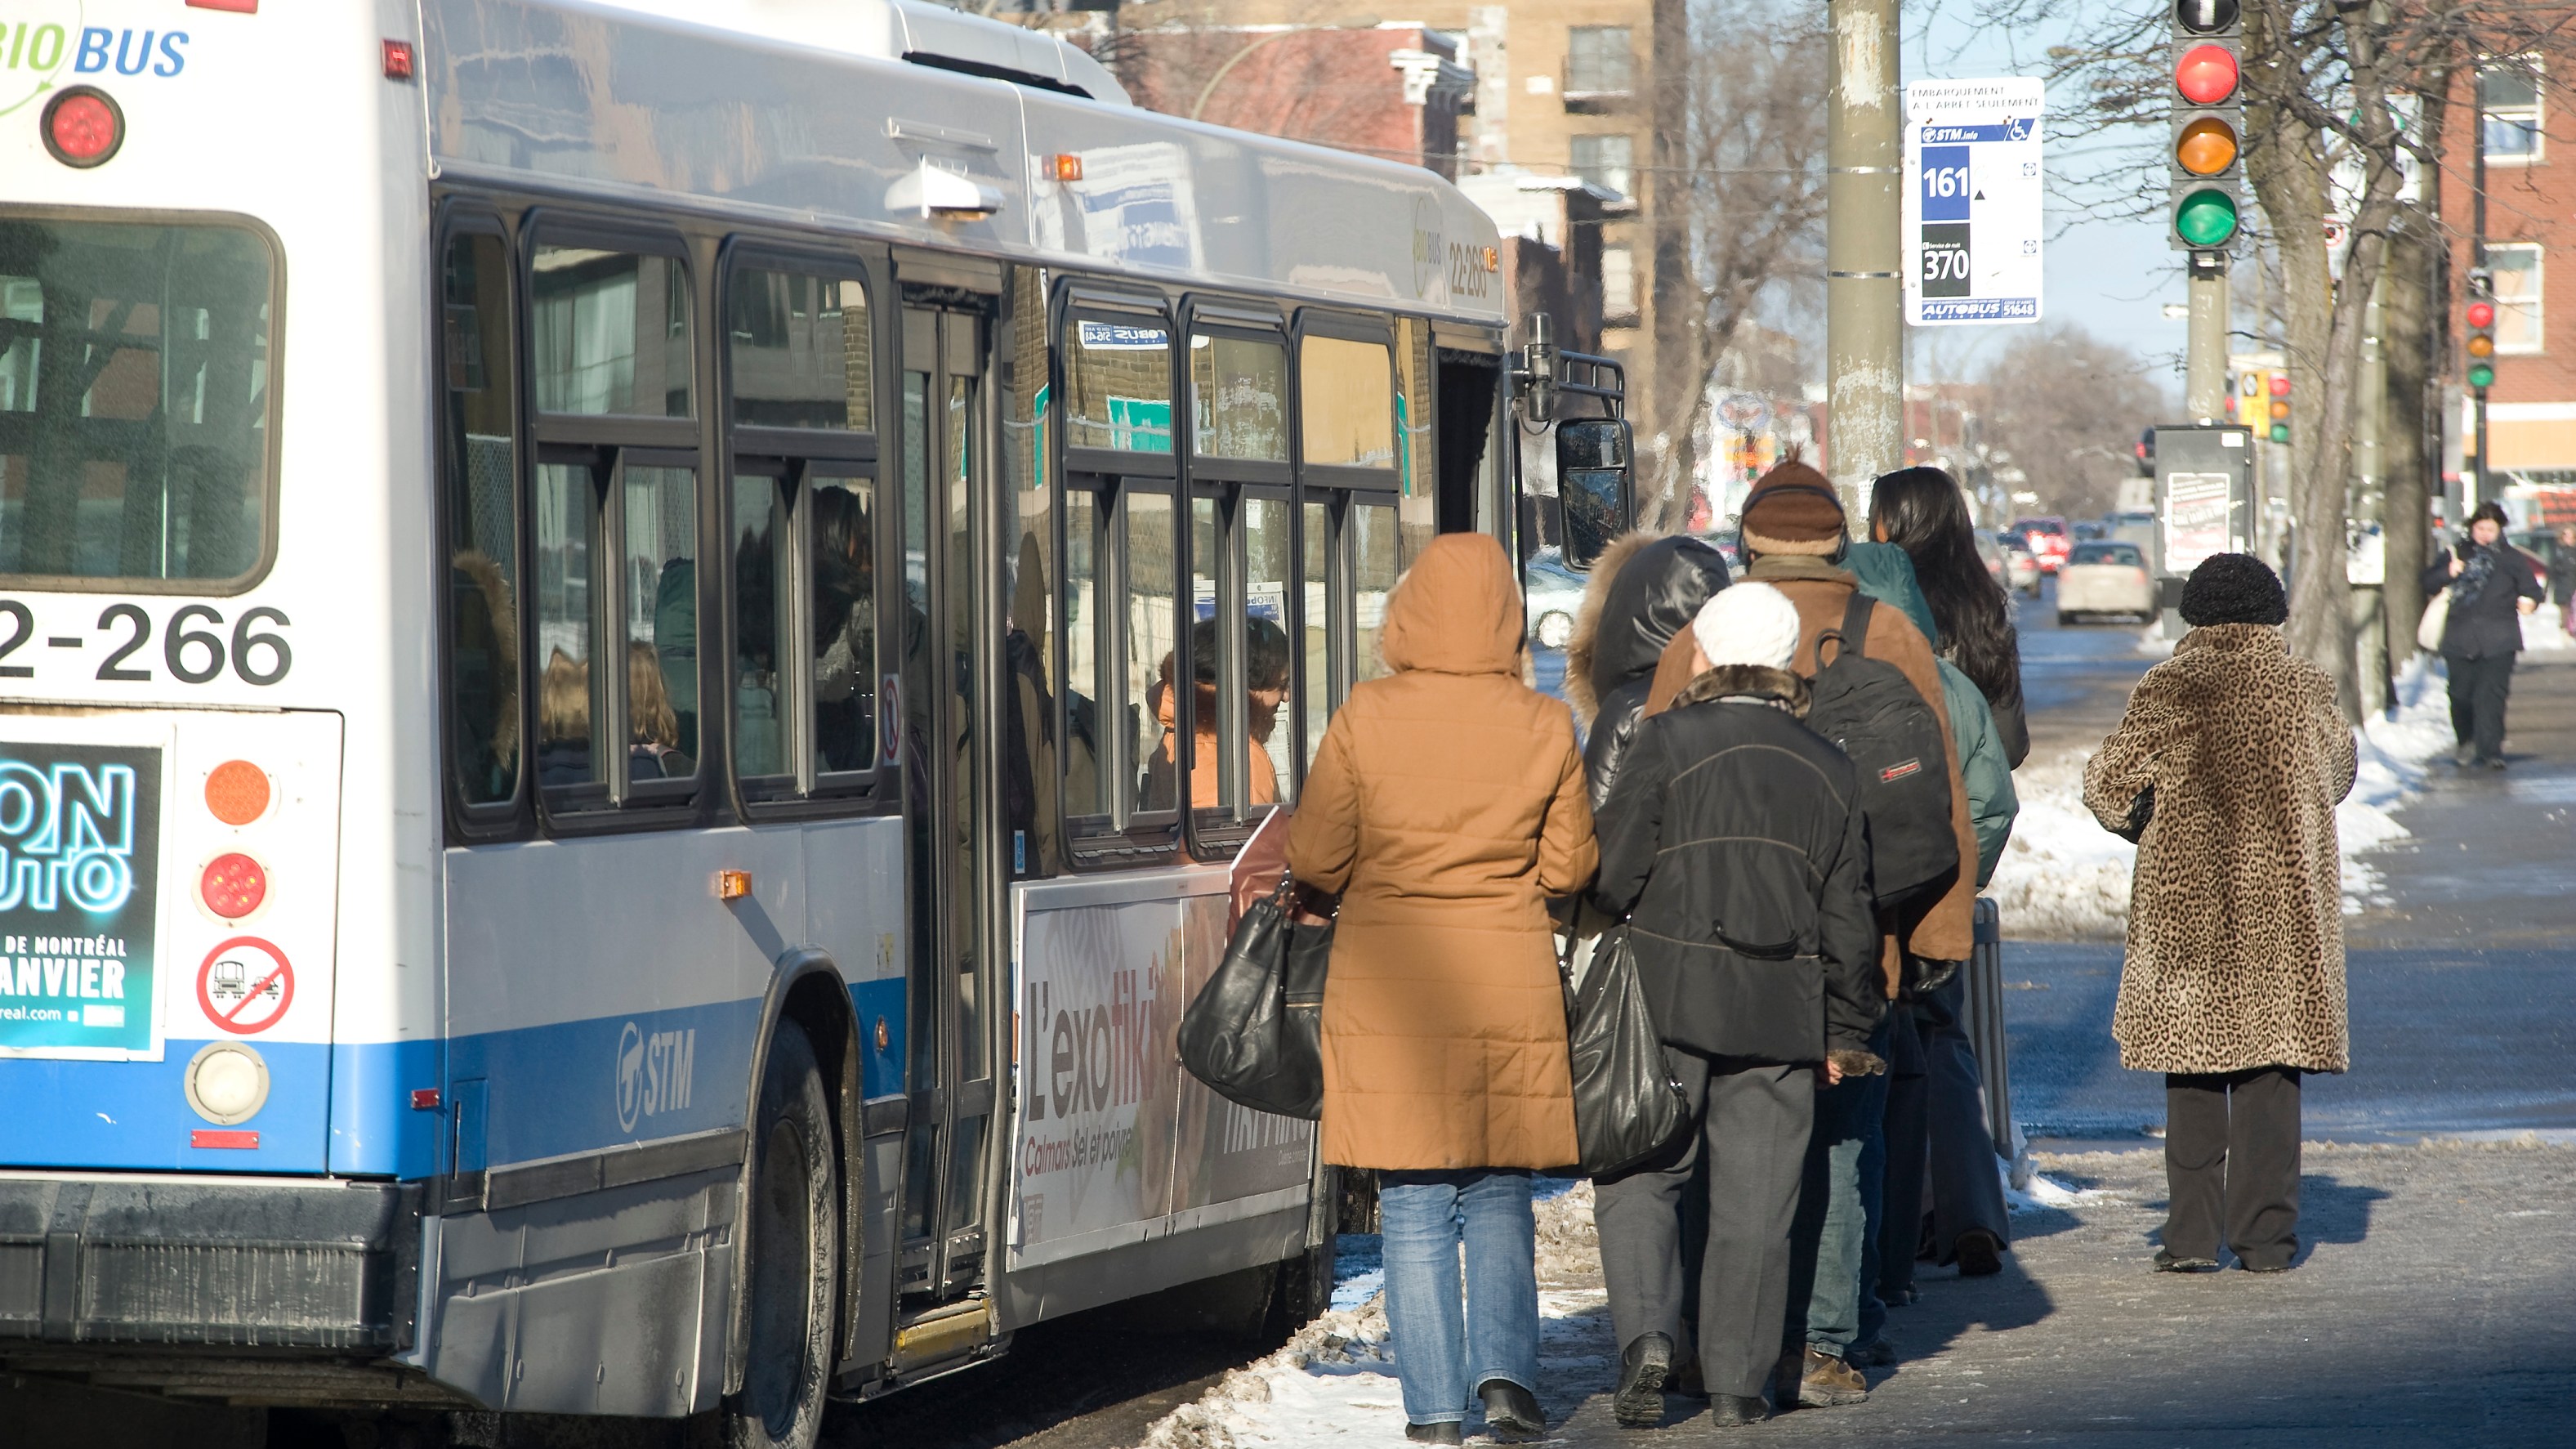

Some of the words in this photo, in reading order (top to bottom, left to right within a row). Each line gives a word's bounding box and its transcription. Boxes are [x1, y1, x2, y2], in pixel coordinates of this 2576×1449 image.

[0, 22, 65, 71] IO
[74, 26, 190, 77] BUS
[1912, 87, 2004, 97] EMBARQUEMENT
[1976, 97, 2038, 108] SEULEMENT
[1922, 166, 1968, 198] 161
[1414, 228, 1427, 262] BIO
[1428, 232, 1441, 265] BUS
[1923, 249, 1970, 280] 370
[2003, 304, 2034, 316] 51648
[0, 601, 292, 686] 2-266
[5, 935, 28, 955] DE
[34, 933, 127, 957] MONTRÉAL
[644, 1028, 695, 1117] STM
[1025, 1134, 1070, 1177] Calmars
[1071, 1126, 1088, 1169] Sel
[1089, 1124, 1101, 1165] et
[1100, 1120, 1132, 1171] poivre
